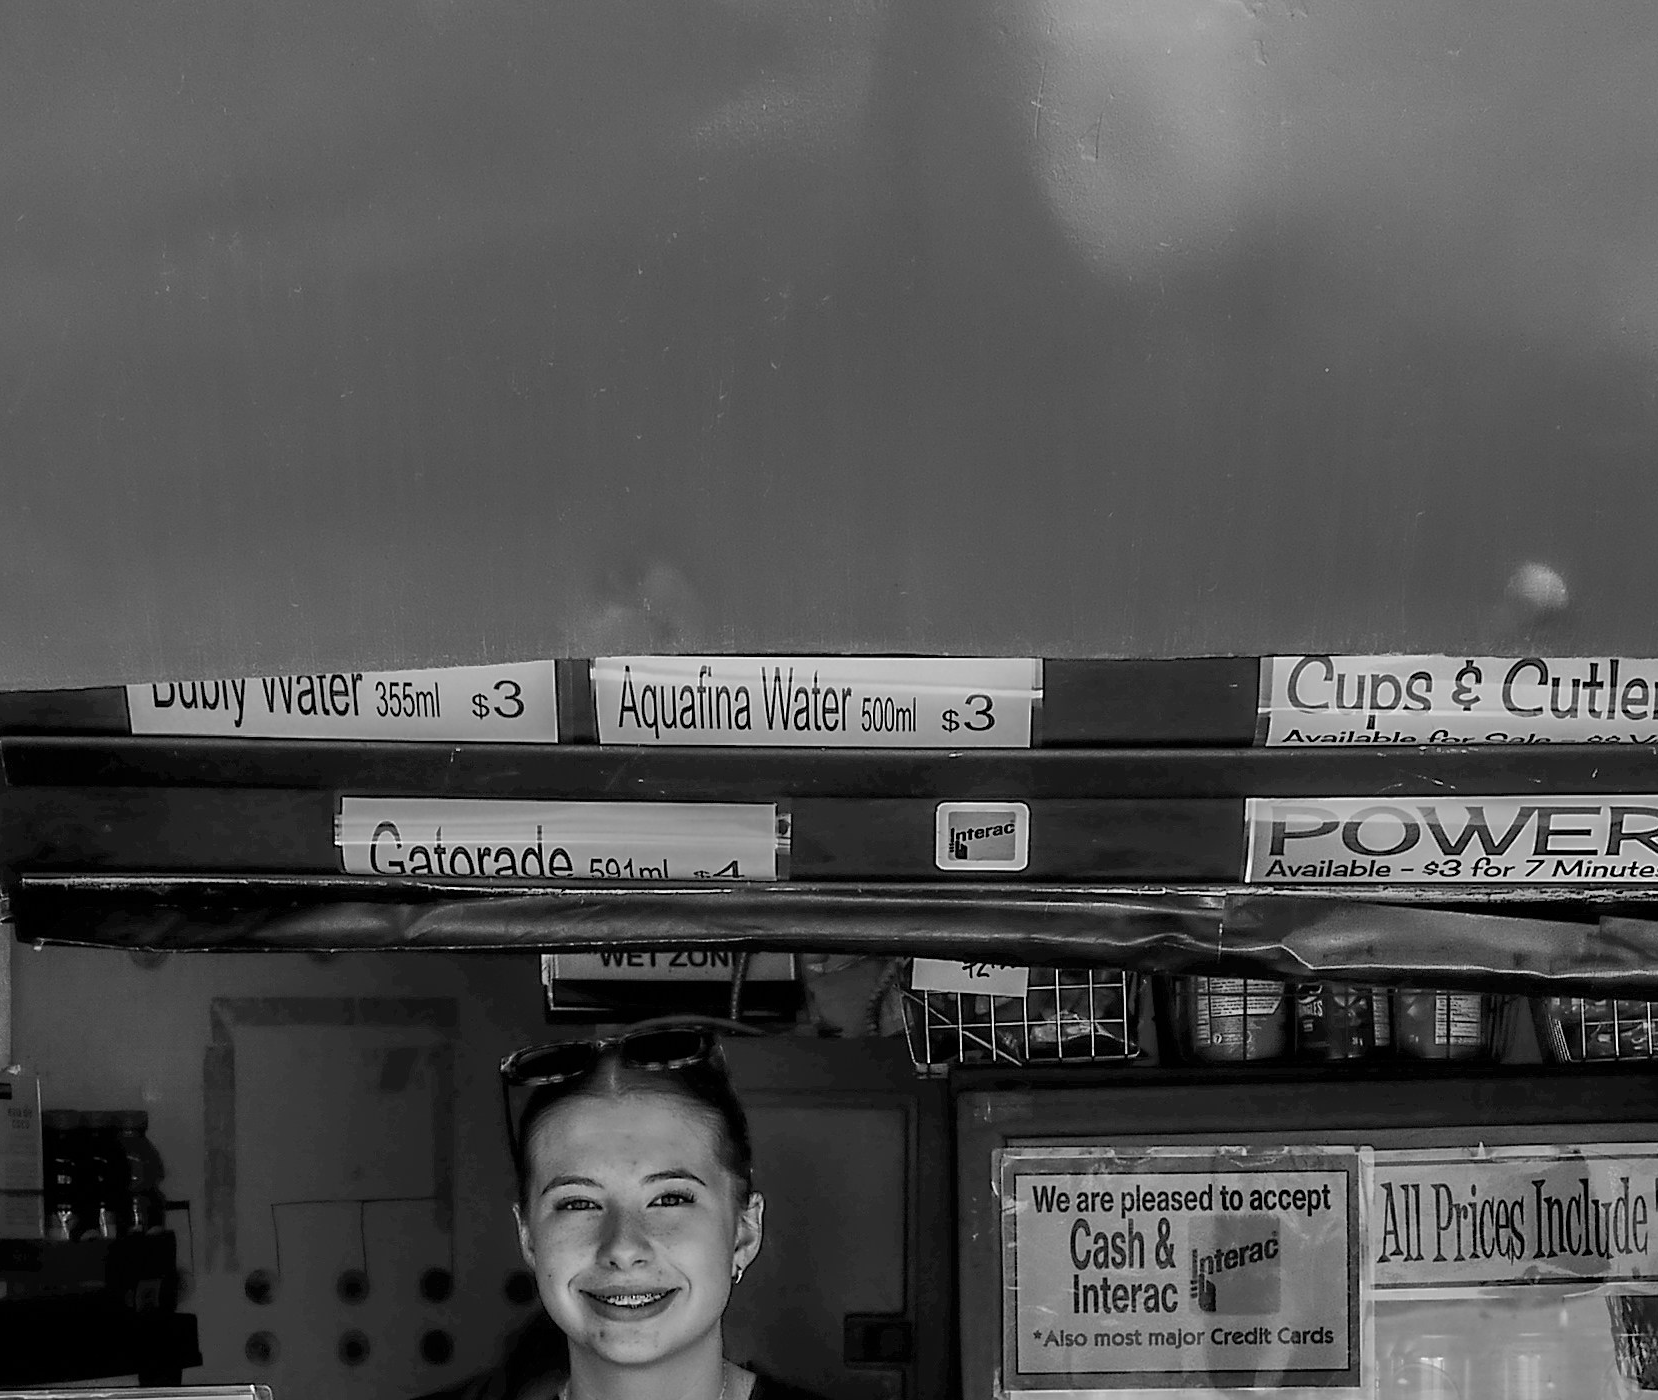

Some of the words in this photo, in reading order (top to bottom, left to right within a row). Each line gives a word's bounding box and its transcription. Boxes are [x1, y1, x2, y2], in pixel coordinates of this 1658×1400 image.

[376, 682, 440, 718] 355ml
[471, 680, 525, 719] $3
[618, 665, 753, 739] Aquafina
[761, 667, 852, 733] Water
[861, 696, 917, 733] 500ml
[942, 694, 996, 733] $3
[1286, 656, 1432, 729] Cups
[1452, 659, 1483, 712] &
[369, 821, 575, 878] Gatorade
[950, 823, 1015, 843] Interac
[1266, 859, 1391, 879] Available
[1422, 859, 1460, 879] $3
[1470, 859, 1516, 880] for
[1525, 859, 1544, 878] 7
[670, 951, 737, 967] ZON
[1033, 1186, 1070, 1214] We
[1075, 1189, 1115, 1211] are
[1121, 1183, 1214, 1217] pleased
[1220, 1185, 1244, 1211] to
[1249, 1184, 1331, 1217] accept
[1377, 1185, 1424, 1262] All
[1432, 1183, 1525, 1262] Prices
[1532, 1176, 1648, 1258] Include
[1070, 1217, 1145, 1272] Cash
[1154, 1217, 1175, 1269] &
[1192, 1230, 1279, 1281] Interac
[1073, 1276, 1178, 1314] Interac
[1094, 1330, 1142, 1348] most
[1149, 1326, 1205, 1351] major
[1211, 1328, 1272, 1345] Credit
[1279, 1326, 1334, 1345] Cards
